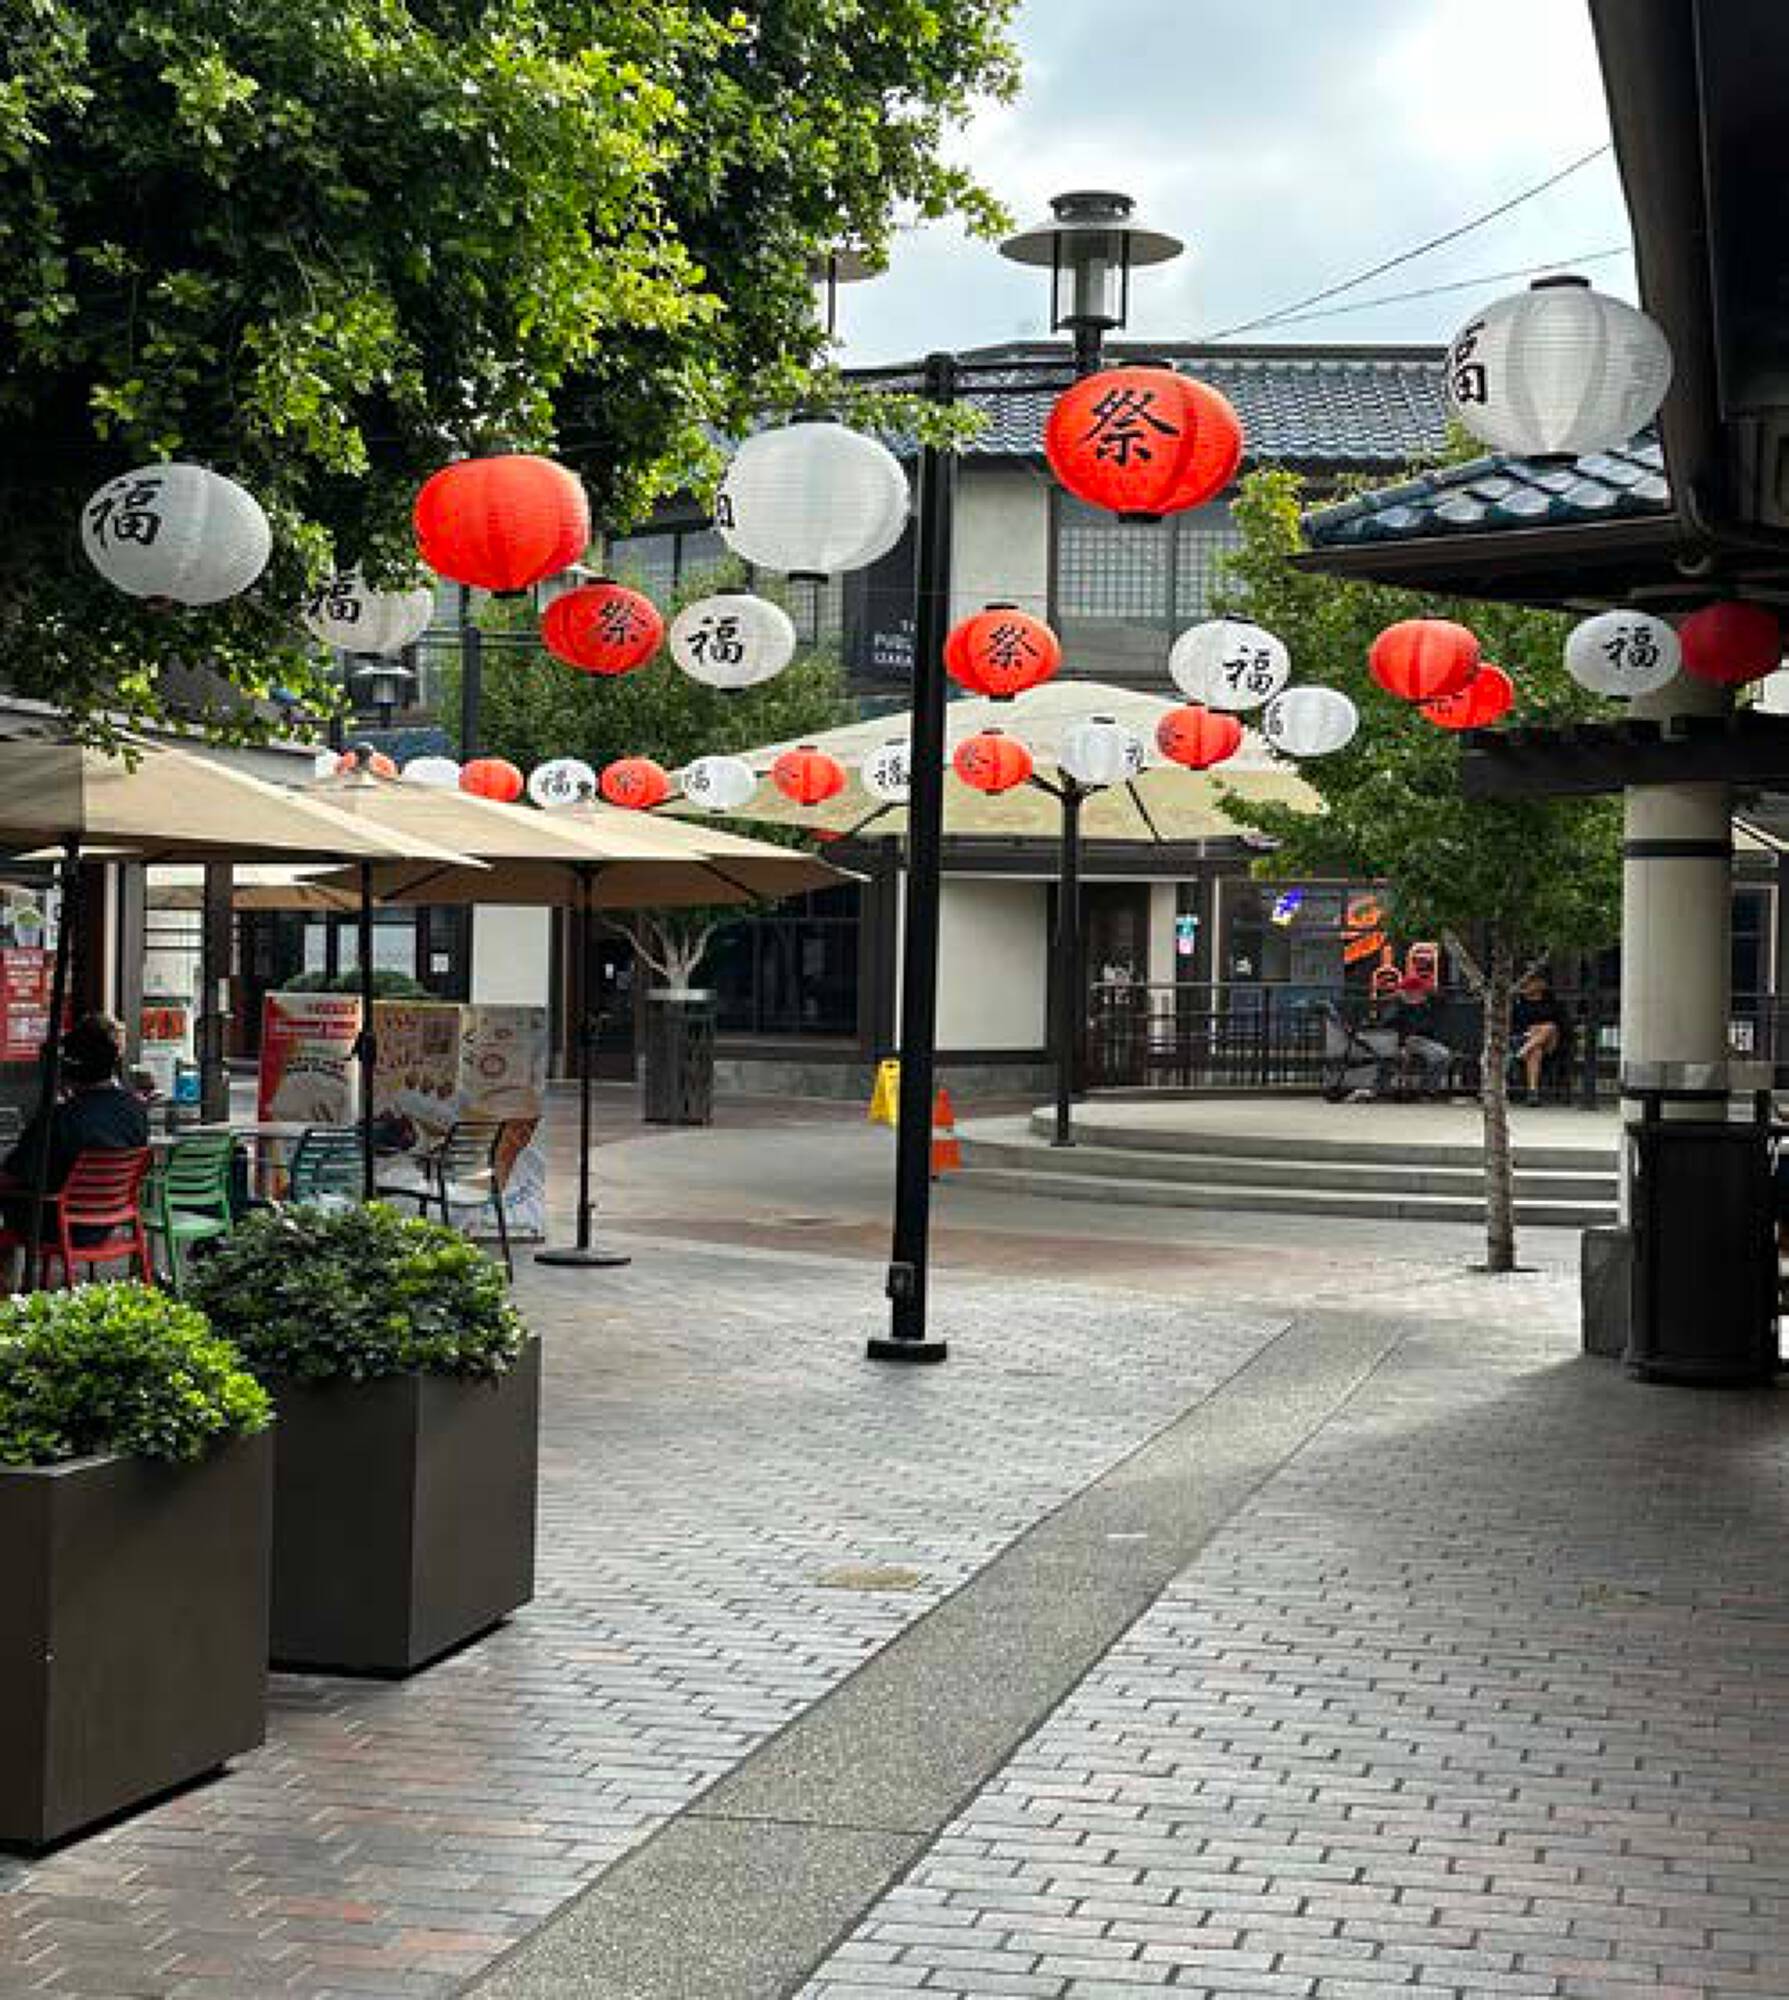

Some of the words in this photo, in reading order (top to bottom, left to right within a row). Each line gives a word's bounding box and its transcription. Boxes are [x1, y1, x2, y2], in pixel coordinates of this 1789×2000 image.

[1079, 388, 1180, 467] 祭
[88, 479, 162, 549] 福
[598, 599, 648, 646] 祭
[687, 616, 743, 664] 福
[979, 624, 1039, 670] 祭
[1222, 645, 1273, 695] 福
[1602, 626, 1660, 670] 福
